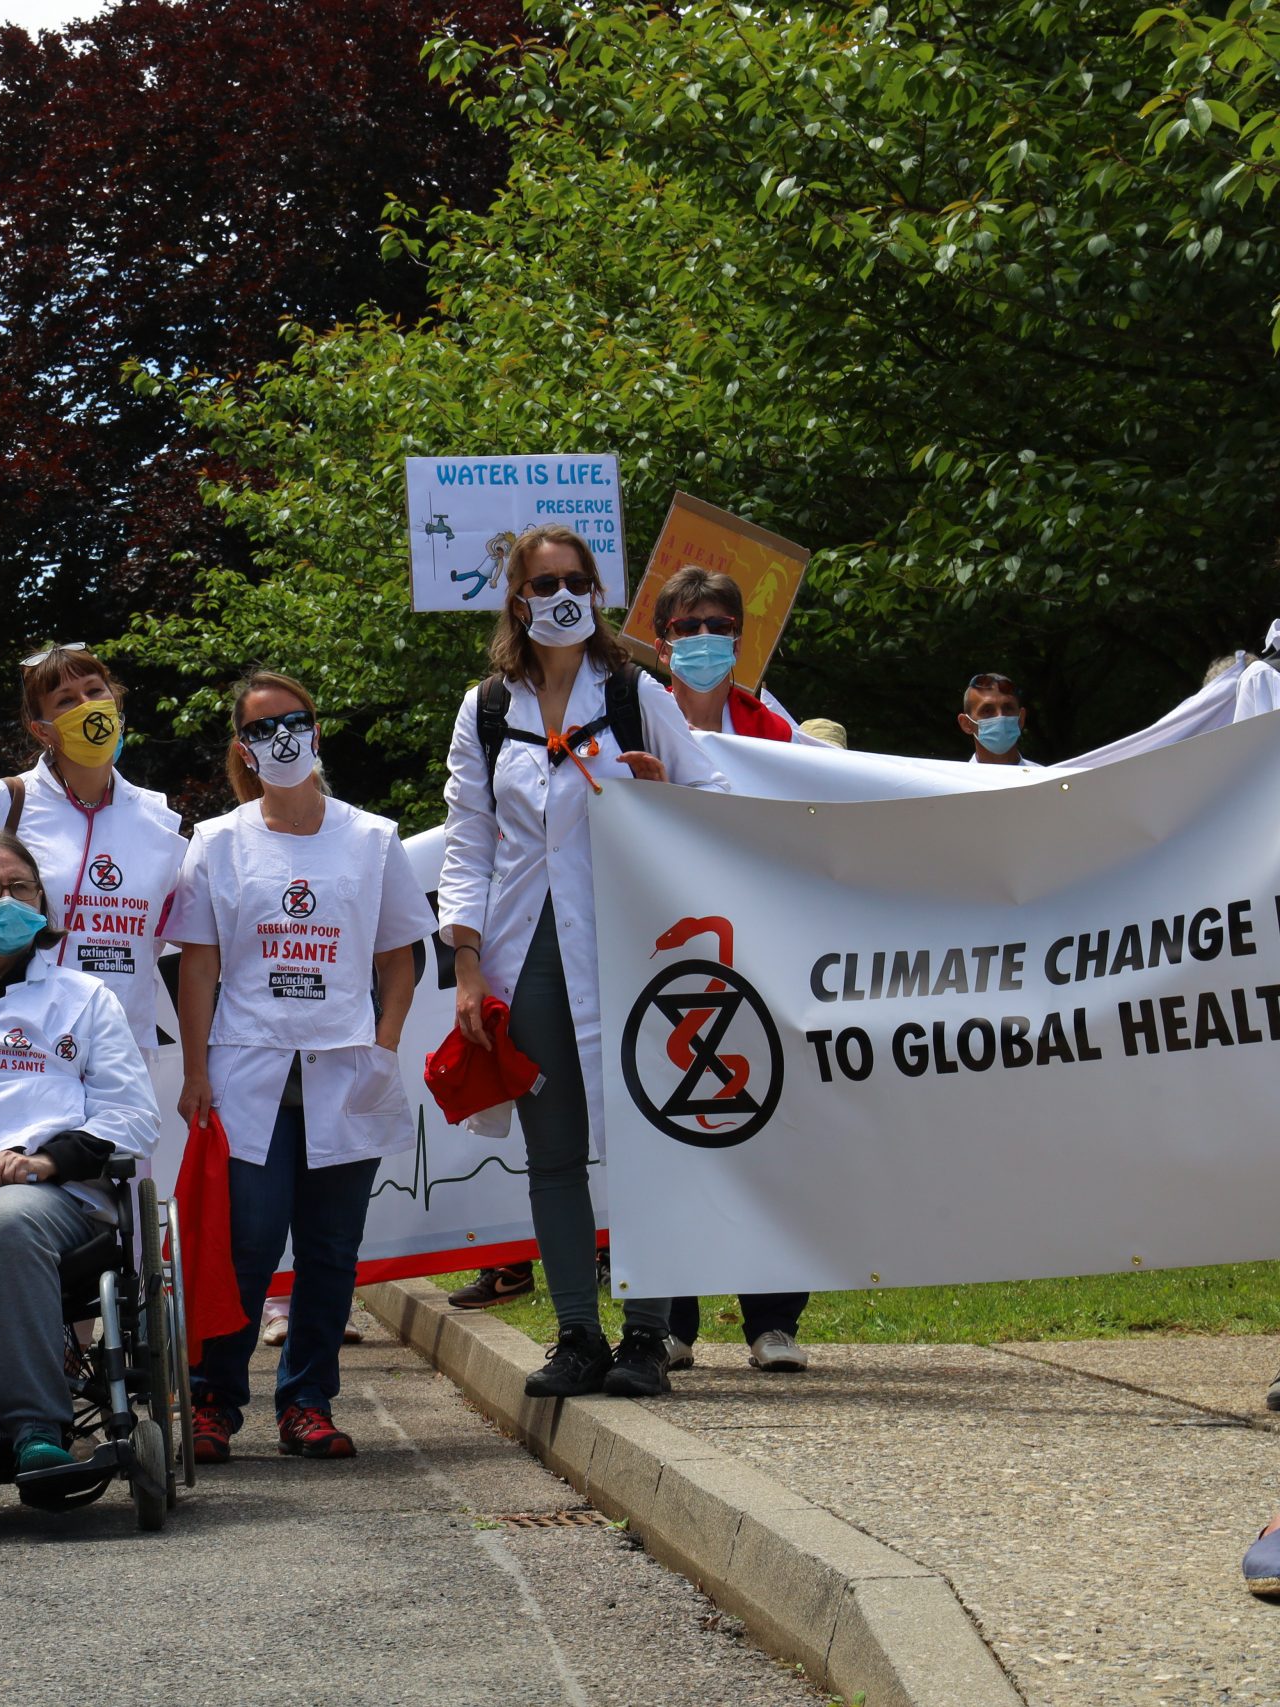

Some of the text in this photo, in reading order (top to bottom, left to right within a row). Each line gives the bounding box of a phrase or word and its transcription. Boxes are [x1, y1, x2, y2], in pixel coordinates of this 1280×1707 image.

[436, 463, 611, 486] WATER IS LIFE,
[536, 500, 614, 514] PRESERVE
[575, 519, 615, 534] IT TO
[587, 538, 616, 554] IVE
[683, 543, 728, 571] HEAT
[64, 895, 149, 911] REBELLION POUR
[92, 914, 146, 936] SANTÉ
[257, 924, 340, 938] REBELLION POUR
[86, 937, 111, 945] Doctors
[80, 946, 125, 959] extinction
[262, 940, 338, 963] LA SANTÉ
[810, 942, 1026, 1002] CLIMATE
[1043, 899, 1257, 986] CHANGE
[94, 960, 134, 973] rebellion
[276, 964, 320, 974] Doctors for XR
[271, 974, 315, 986] extinction
[282, 986, 324, 999] rebellion
[806, 1026, 874, 1083] TO
[892, 1007, 1103, 1077] GLOBAL
[12, 1060, 45, 1073] SANTÉ
